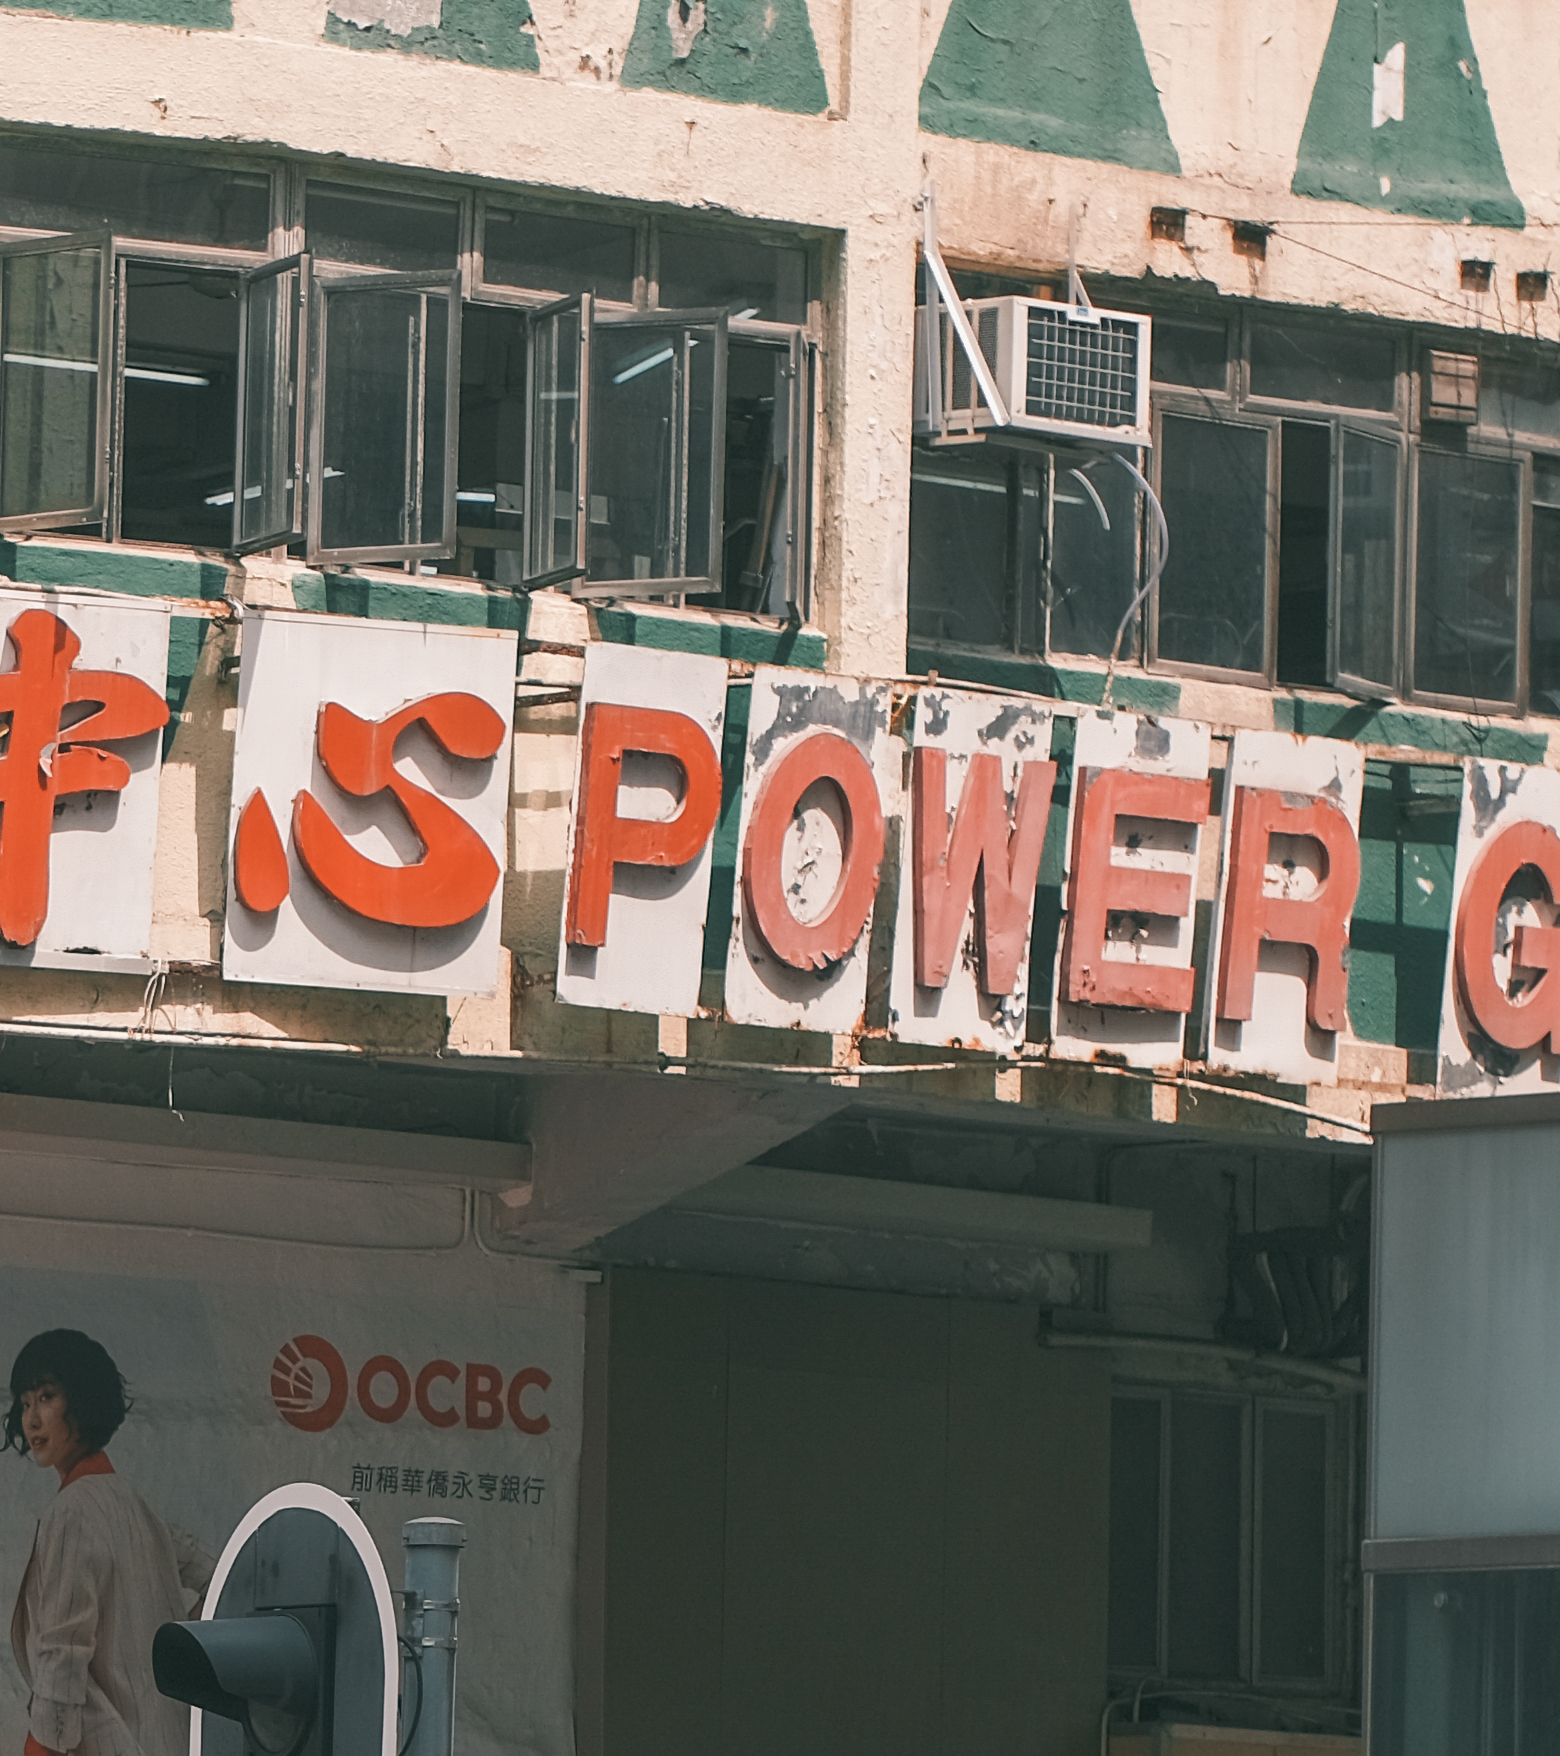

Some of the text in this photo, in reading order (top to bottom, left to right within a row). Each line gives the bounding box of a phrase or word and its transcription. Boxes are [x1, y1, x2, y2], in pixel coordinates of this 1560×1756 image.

[564, 701, 1361, 1031] POWER
[356, 1355, 552, 1436] OCBC
[351, 1463, 546, 1505] 前稱華僑永亨銀行
